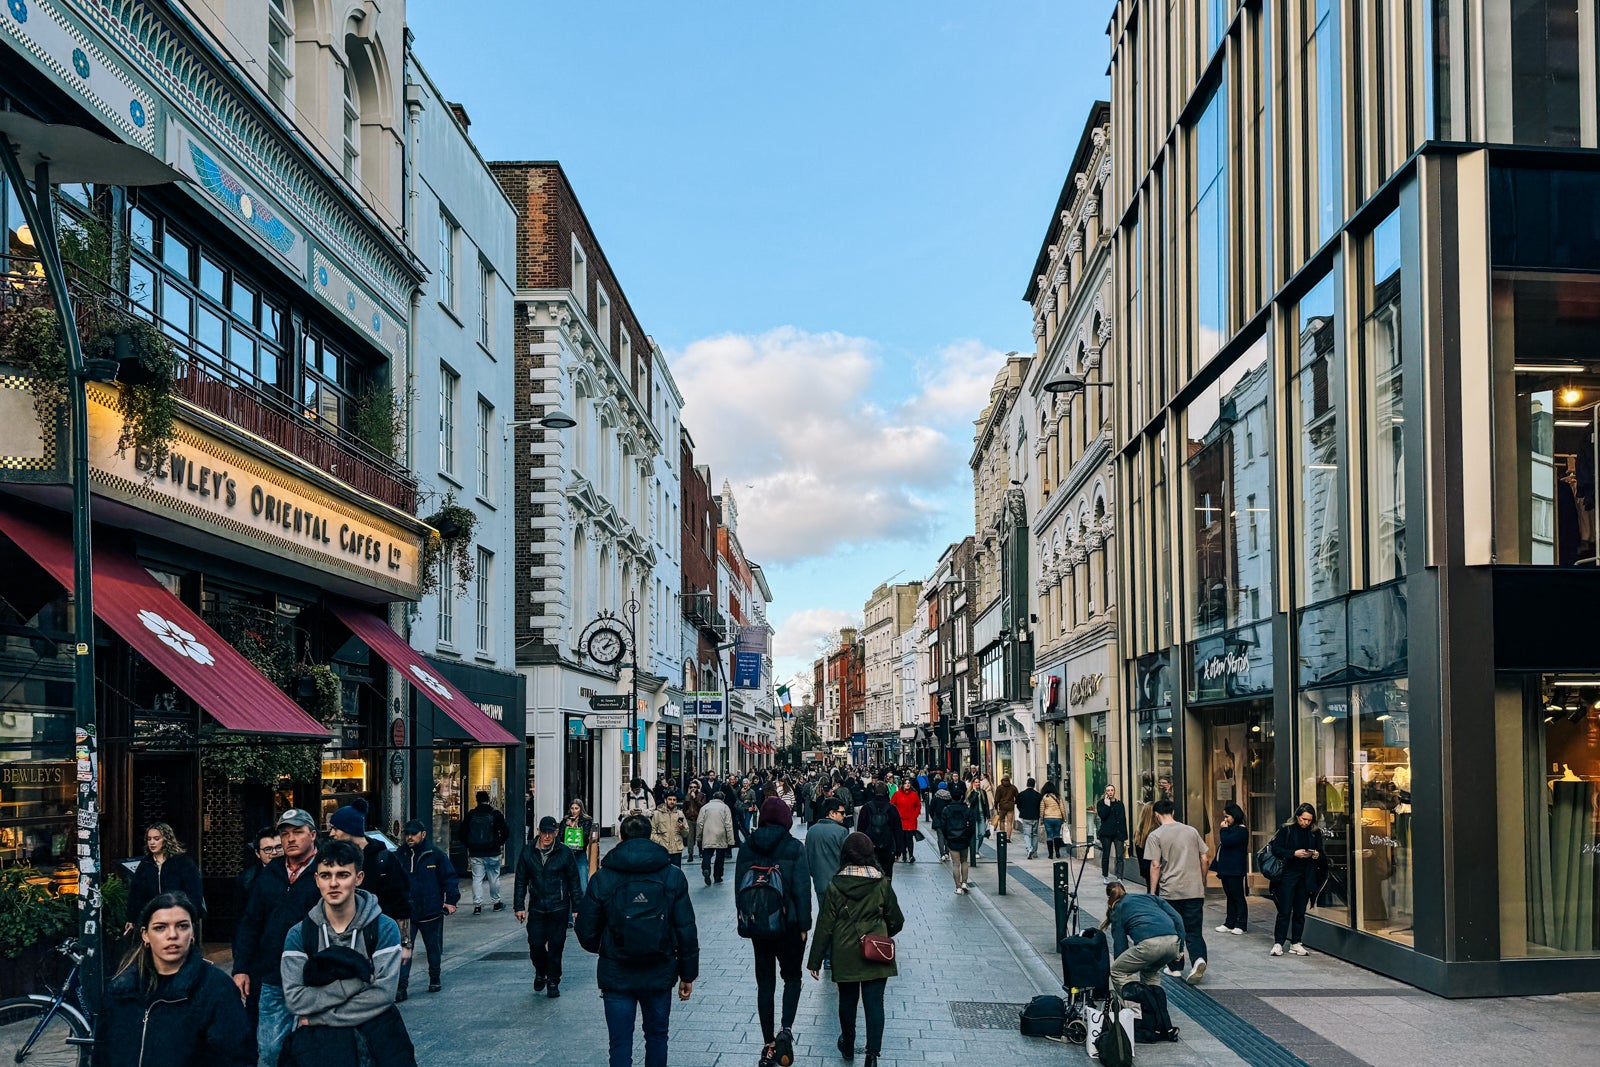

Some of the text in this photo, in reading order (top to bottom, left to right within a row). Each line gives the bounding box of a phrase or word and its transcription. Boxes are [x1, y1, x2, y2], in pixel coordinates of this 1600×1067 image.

[251, 485, 331, 544] ORIENTAL
[340, 523, 381, 563] CAFÉS
[1204, 659, 1210, 680] &
[3, 768, 61, 783] BEWLEY'S
